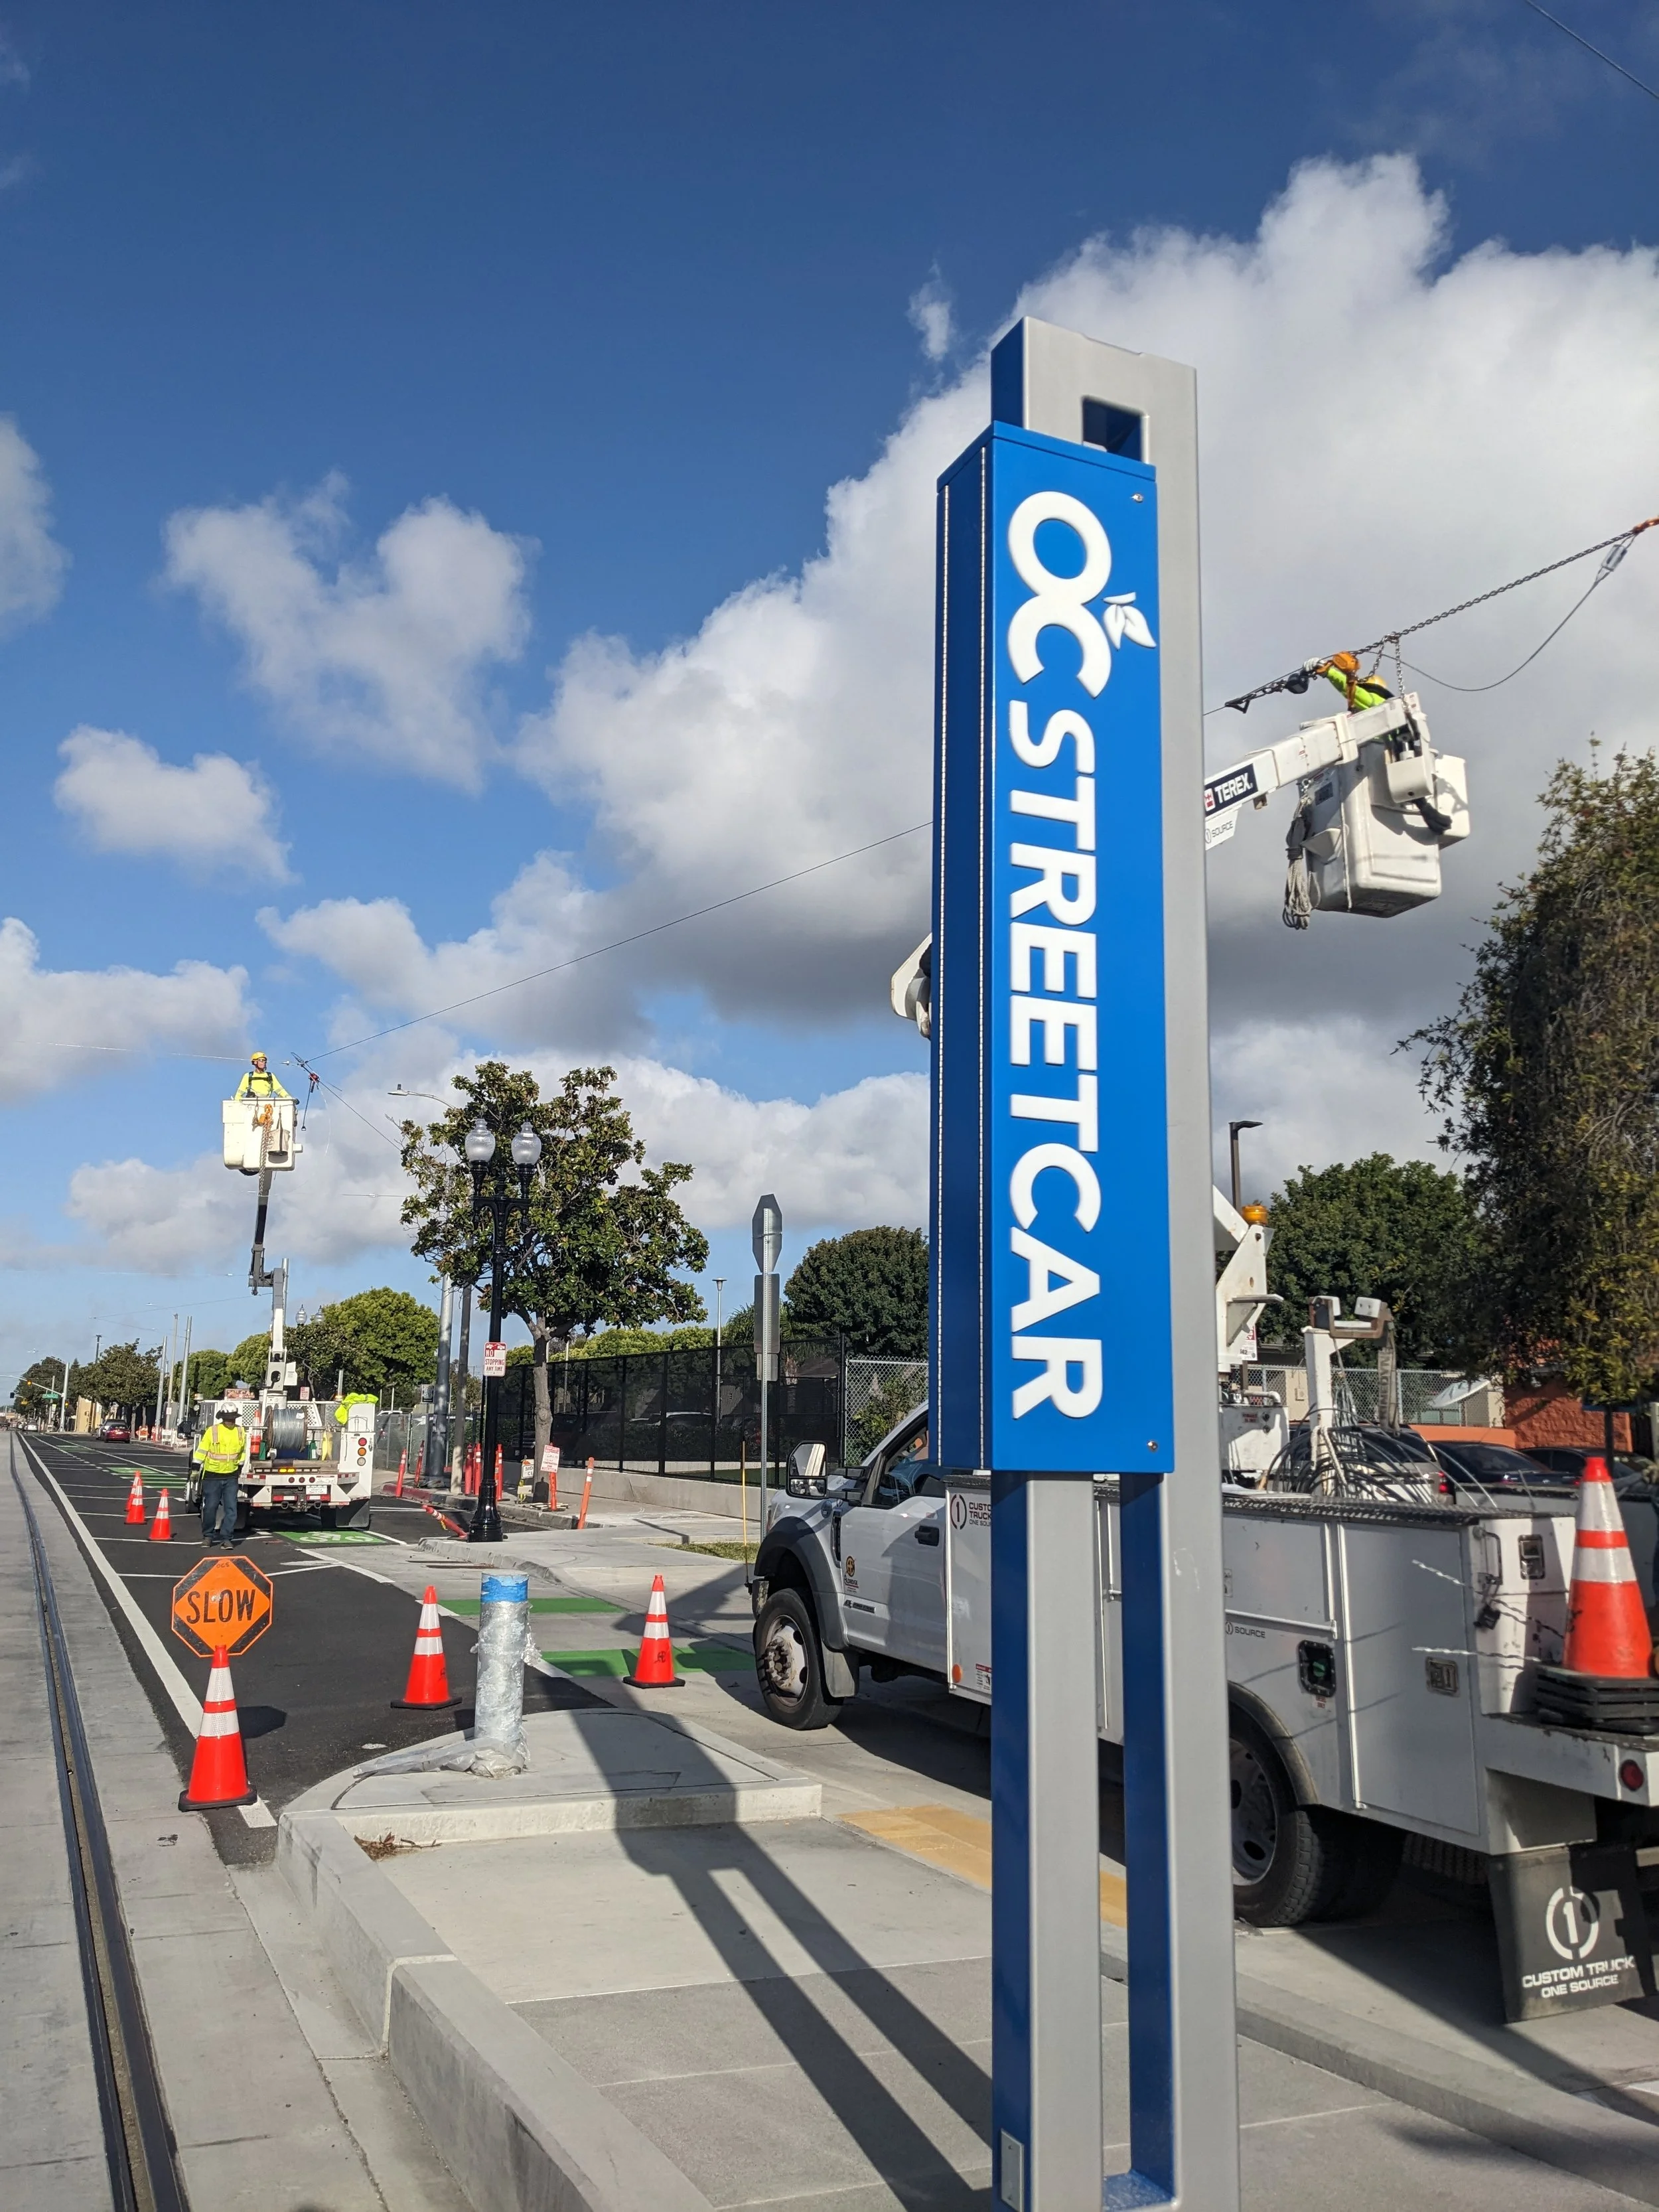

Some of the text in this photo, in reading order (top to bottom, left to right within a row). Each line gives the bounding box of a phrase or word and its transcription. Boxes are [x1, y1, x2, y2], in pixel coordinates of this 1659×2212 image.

[1214, 773, 1253, 804] TEREX
[1211, 820, 1234, 838] SOURCE
[1007, 491, 1112, 1420] OC STREETCAR
[969, 1502, 991, 1512] CUSTO
[186, 1589, 256, 1625] SLOW
[1235, 1627, 1265, 1638] SOURCE
[1522, 1955, 1635, 1988] CUSTOM TRUCK
[1541, 1974, 1620, 1999] ONE SOURCE
